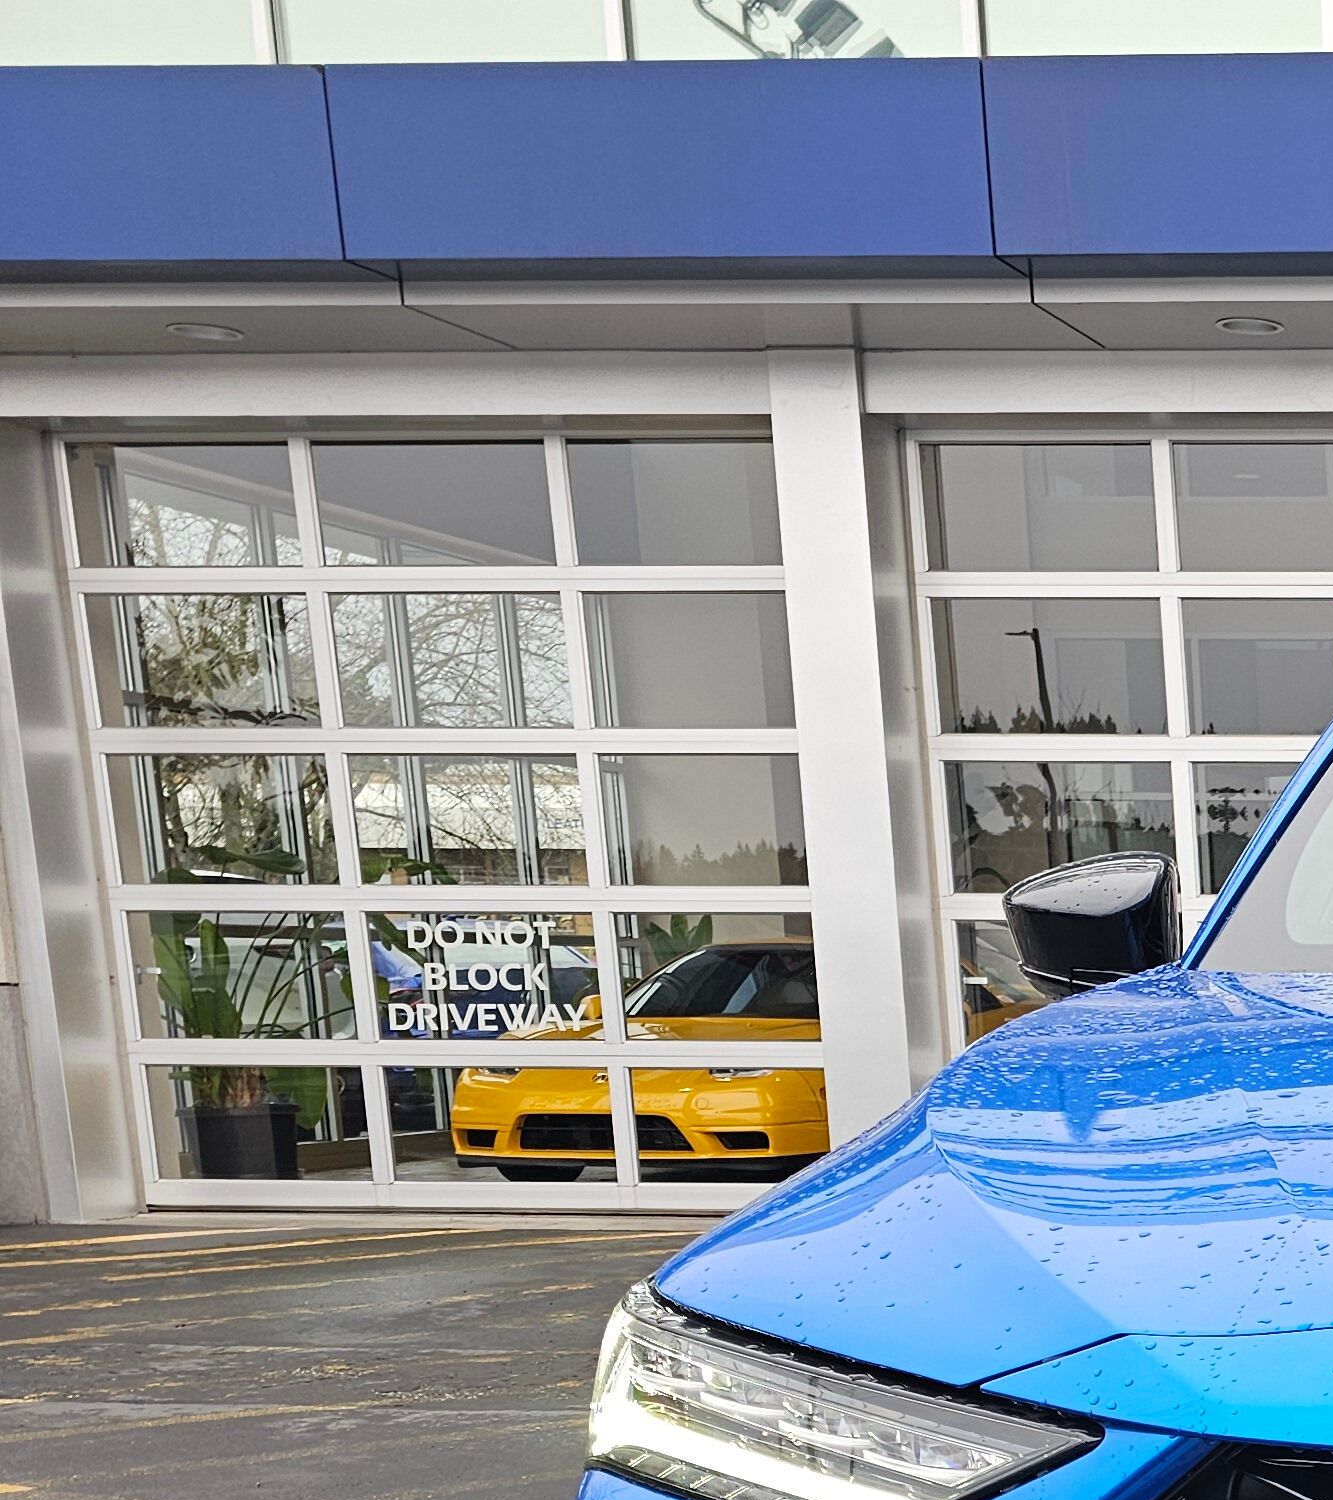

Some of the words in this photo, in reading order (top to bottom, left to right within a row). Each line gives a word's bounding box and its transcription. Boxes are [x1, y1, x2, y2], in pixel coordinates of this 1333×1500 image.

[406, 921, 465, 949] DO
[475, 921, 557, 949] NOT
[424, 962, 549, 991] BLOCK
[388, 1003, 587, 1032] DRIVEWAY
